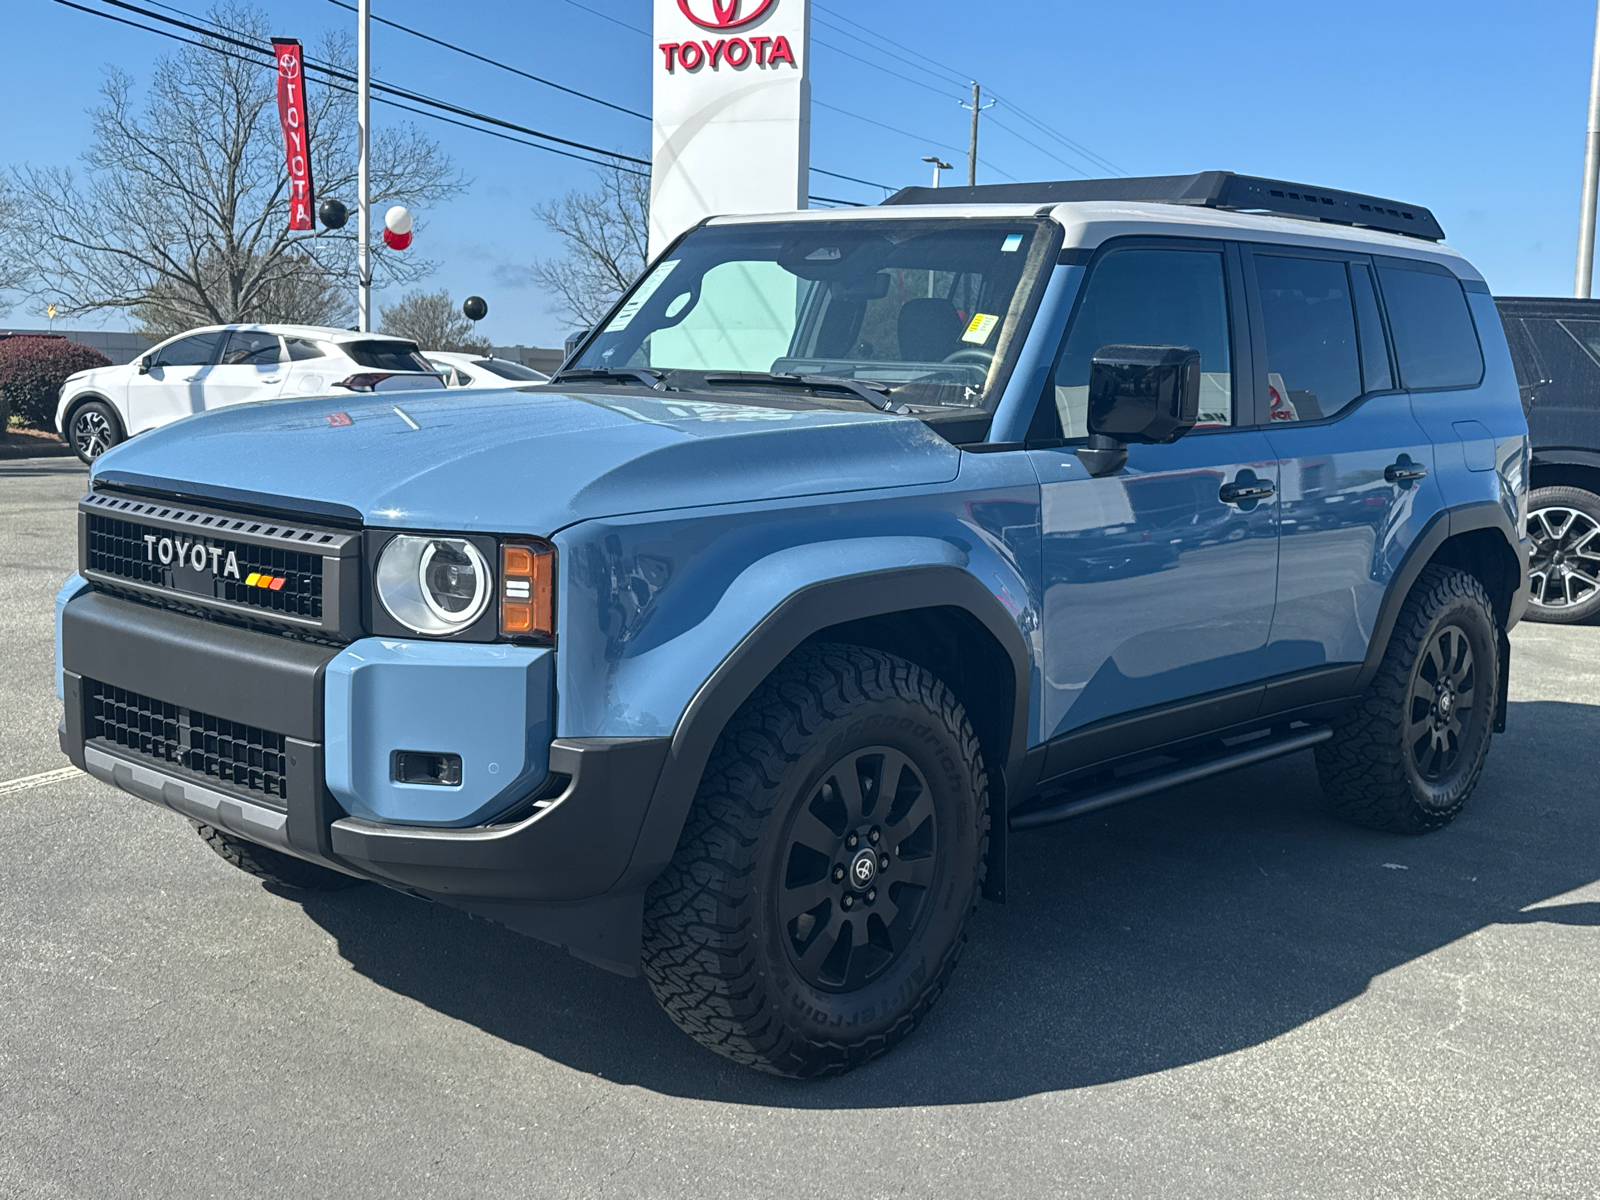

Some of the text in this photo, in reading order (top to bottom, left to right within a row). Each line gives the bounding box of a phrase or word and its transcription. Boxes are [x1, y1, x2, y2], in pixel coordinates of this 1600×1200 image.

[659, 35, 795, 72] TOYOTA
[287, 83, 310, 223] TOYOTA
[144, 535, 240, 579] TOYOTA
